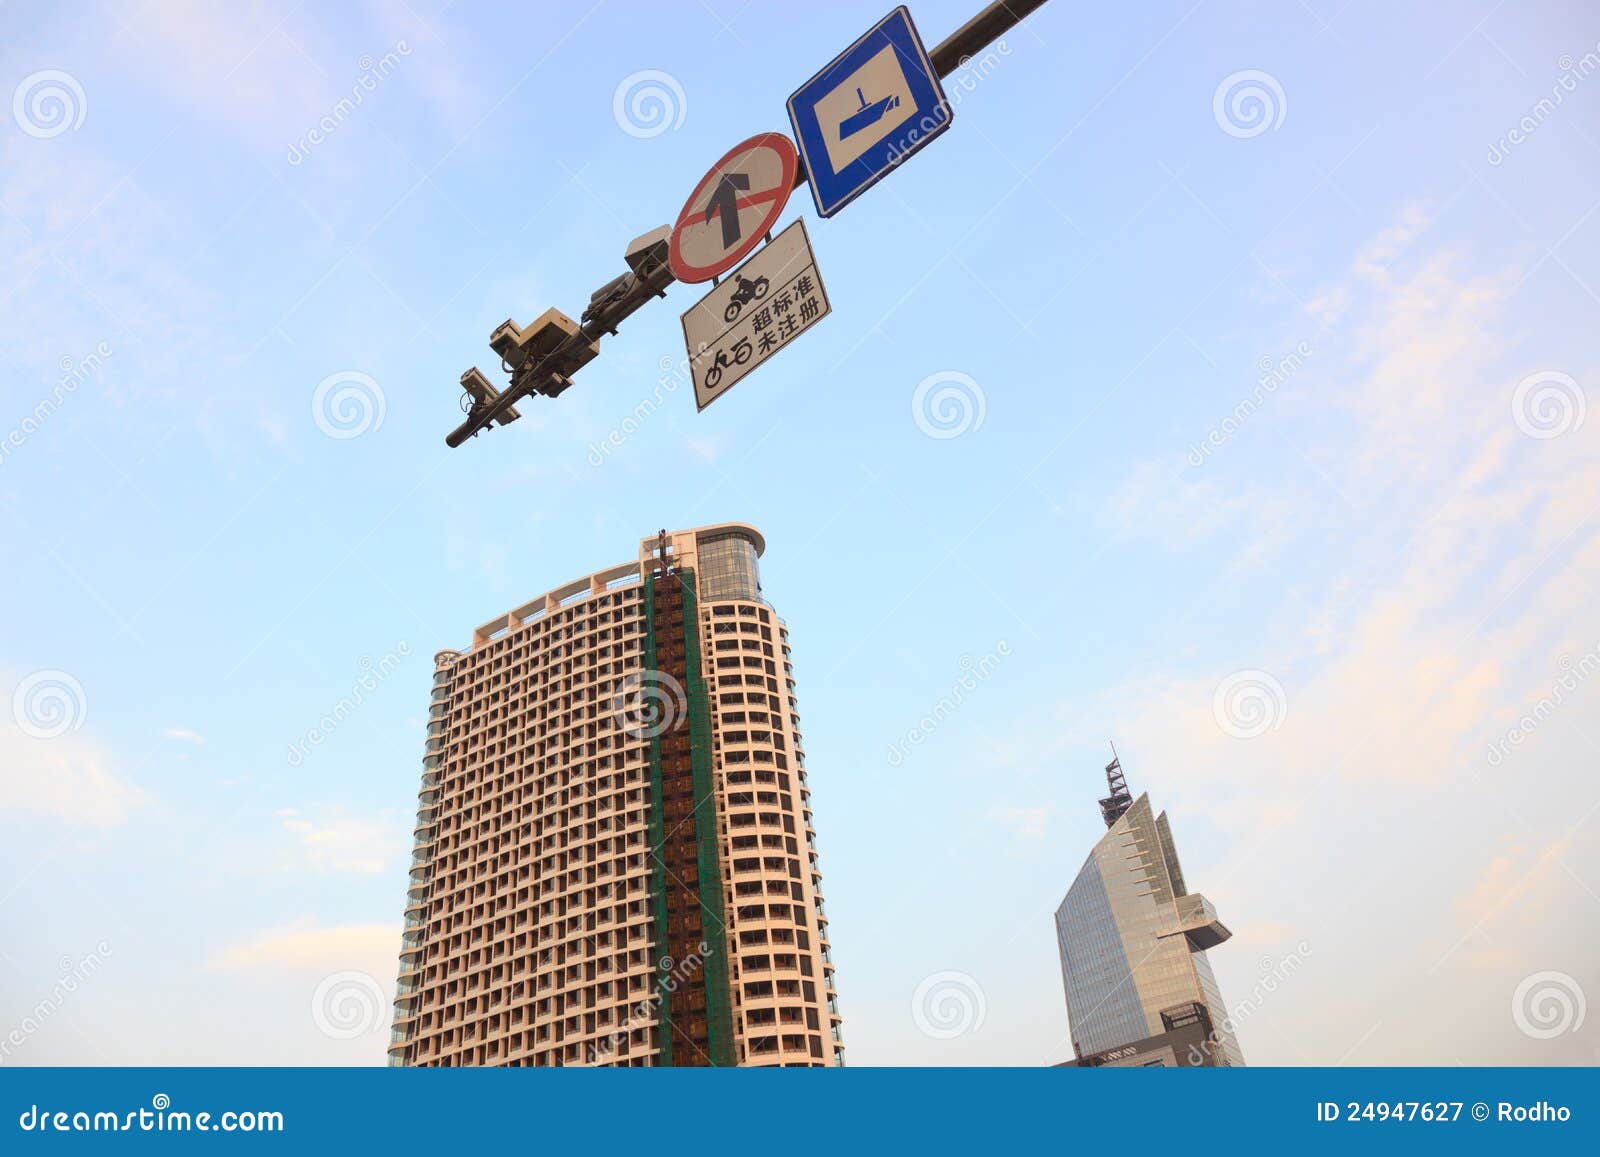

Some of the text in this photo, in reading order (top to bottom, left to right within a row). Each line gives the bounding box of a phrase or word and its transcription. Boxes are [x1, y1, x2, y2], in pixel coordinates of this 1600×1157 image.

[752, 276, 814, 335] 超标准
[758, 296, 819, 355] 未注册
